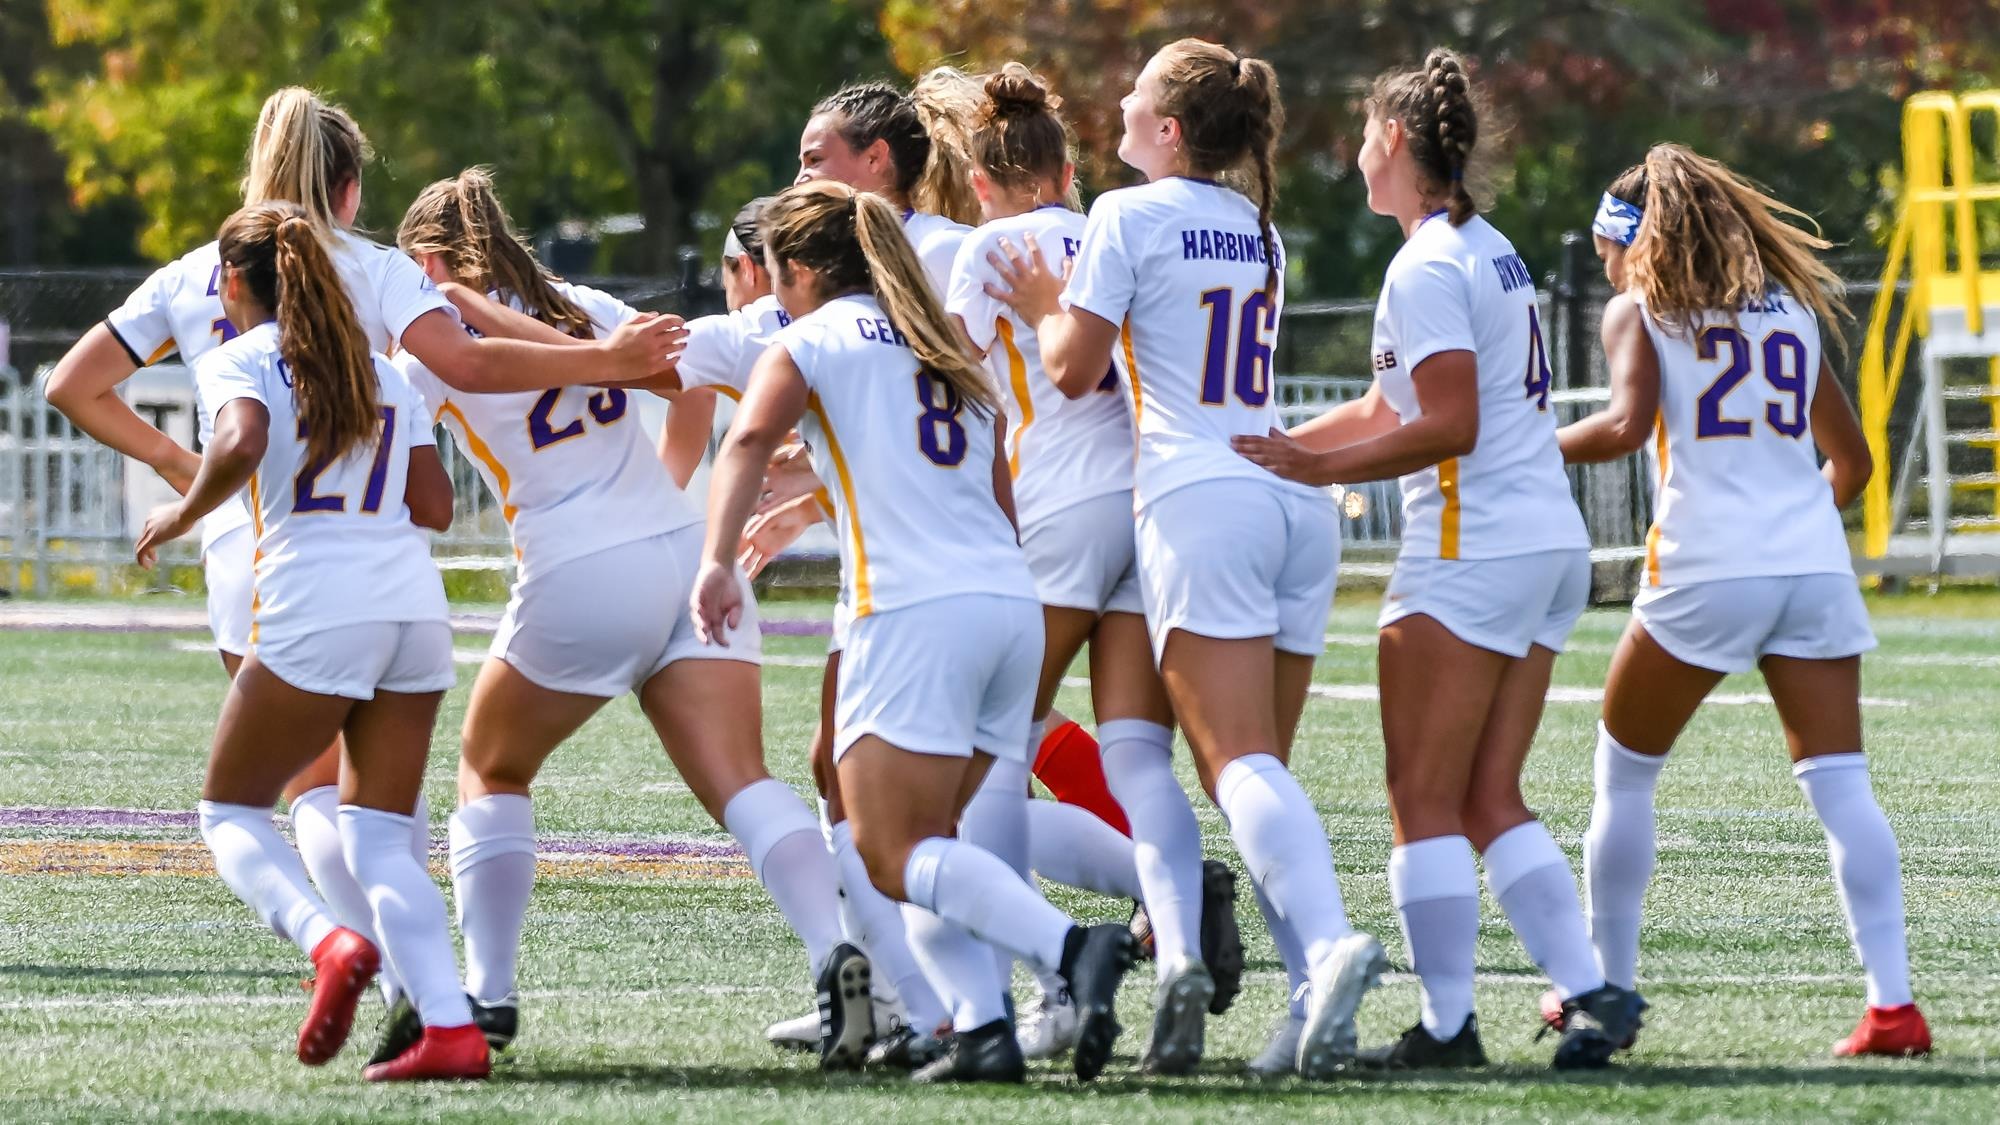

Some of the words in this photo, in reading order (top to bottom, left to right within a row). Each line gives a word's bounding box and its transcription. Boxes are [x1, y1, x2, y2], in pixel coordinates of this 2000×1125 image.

[1182, 229, 1283, 271] HARBINGR
[1200, 287, 1276, 408] 16
[1525, 303, 1551, 412] 4
[1696, 323, 1808, 441] 29
[914, 367, 968, 469] 8
